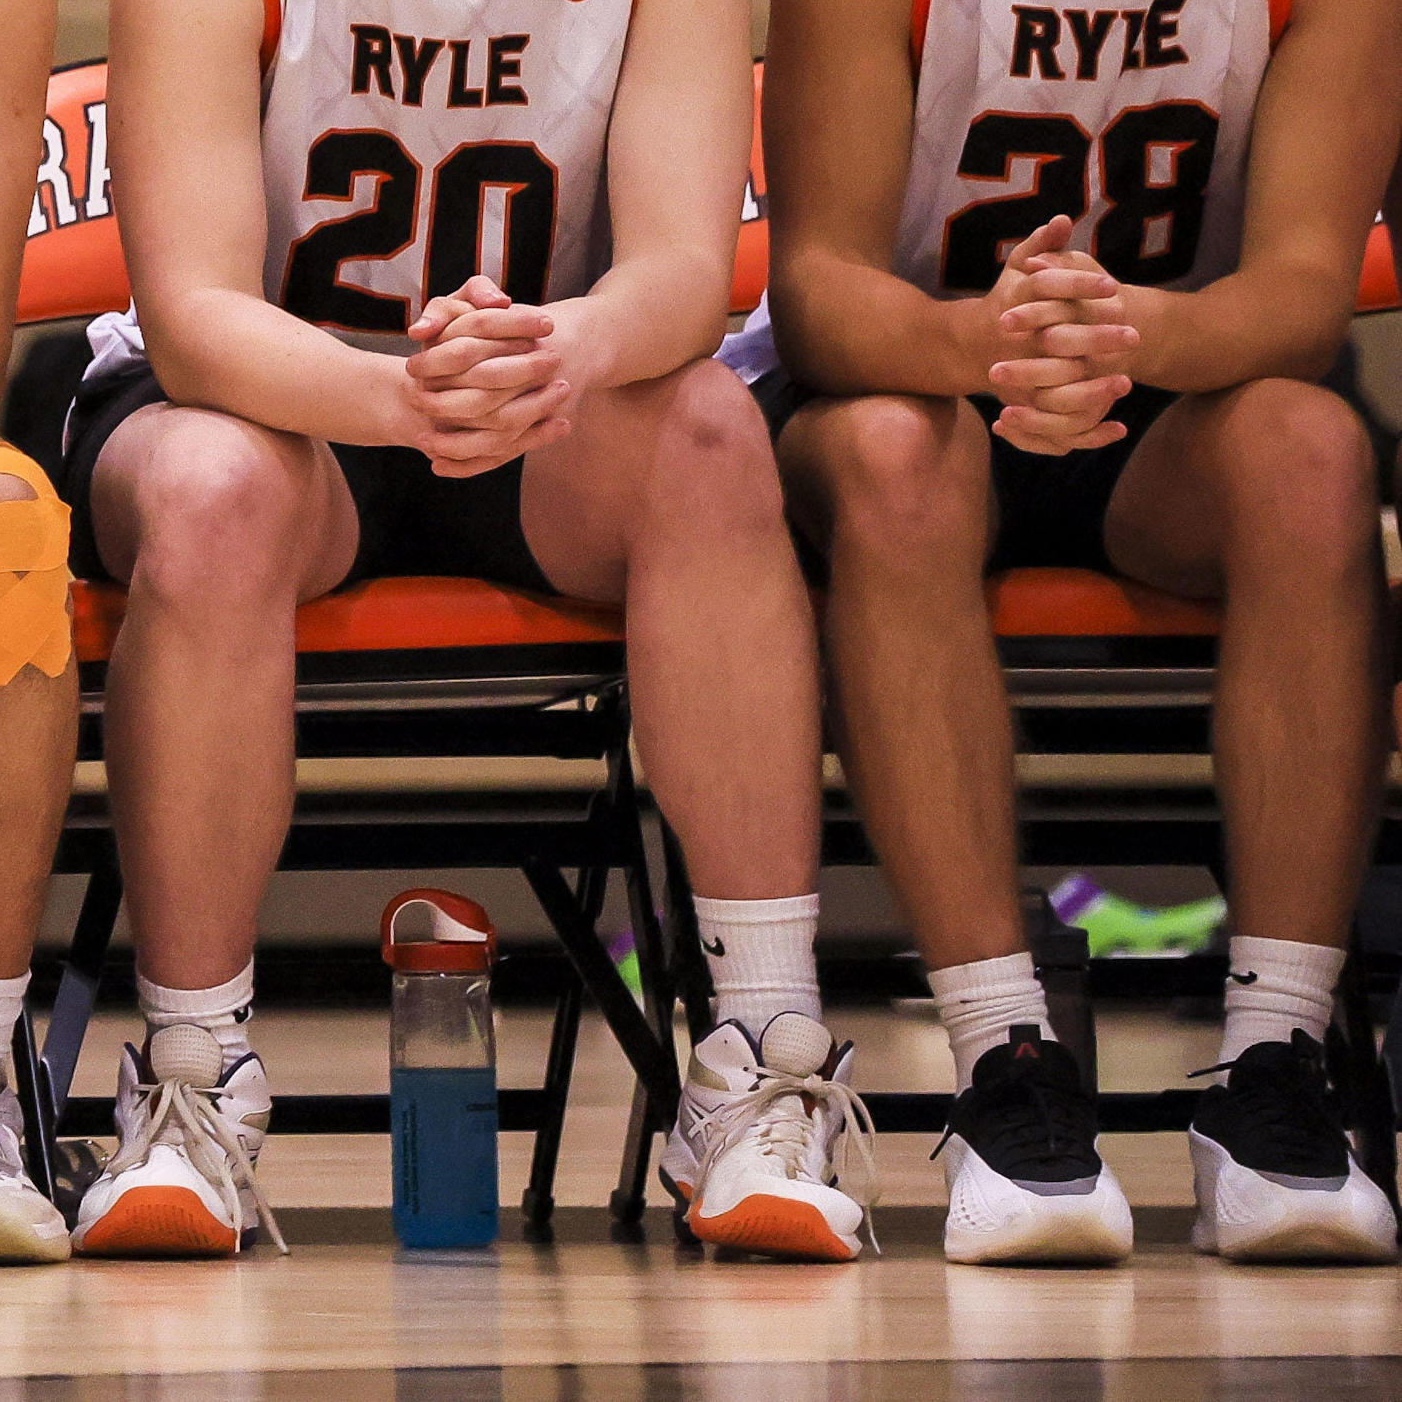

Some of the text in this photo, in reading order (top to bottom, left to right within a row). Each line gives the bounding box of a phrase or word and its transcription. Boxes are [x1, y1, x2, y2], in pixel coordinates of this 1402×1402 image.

[350, 23, 530, 109] RYLE
[278, 127, 558, 335] 20
[939, 98, 1220, 297] 28
